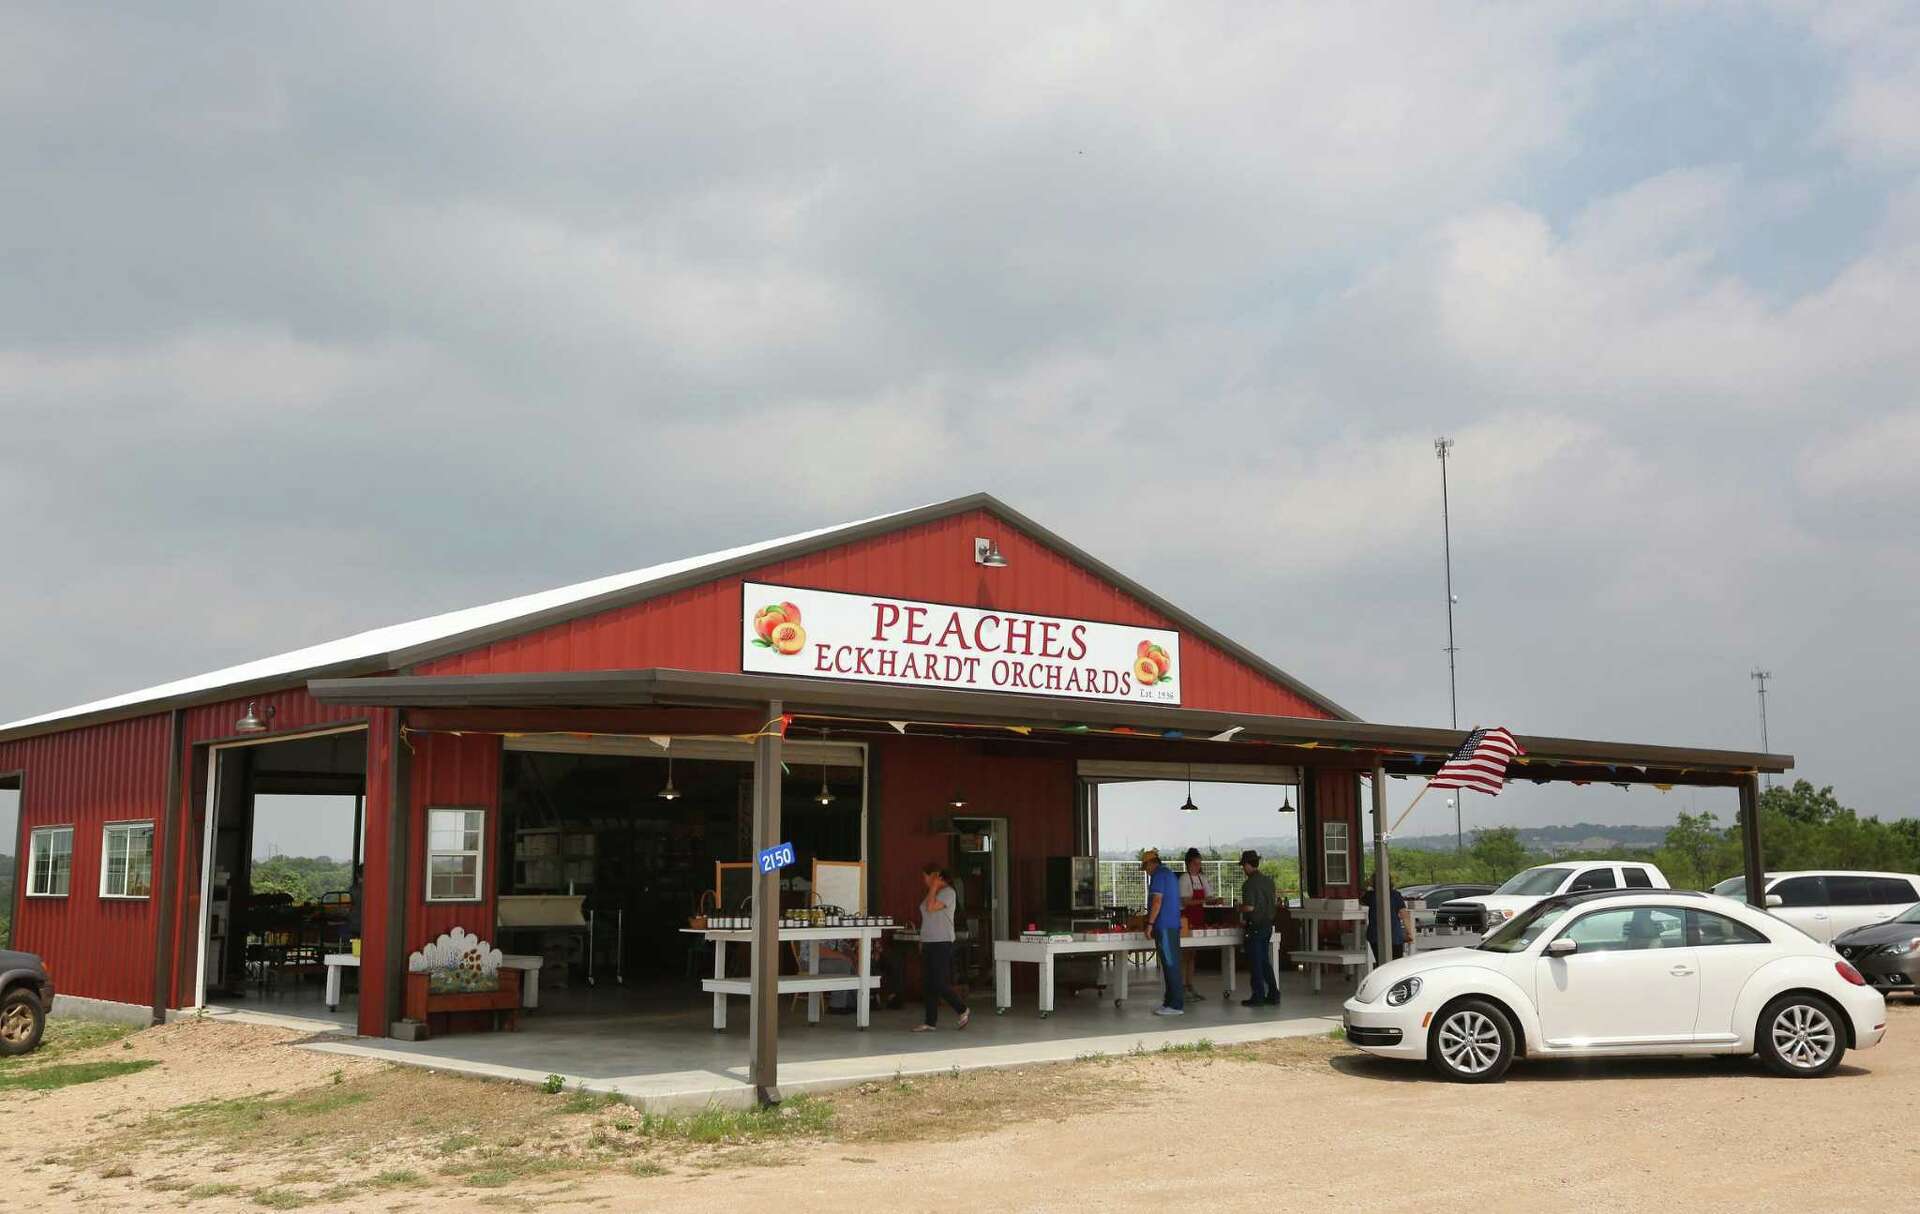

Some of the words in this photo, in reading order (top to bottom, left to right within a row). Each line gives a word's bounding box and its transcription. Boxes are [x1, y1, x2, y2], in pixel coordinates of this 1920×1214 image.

[872, 603, 1087, 660] PEACHES
[815, 644, 980, 683] ECKHARDT
[991, 660, 1132, 695] ORCHARDS
[762, 848, 791, 871] 2150
